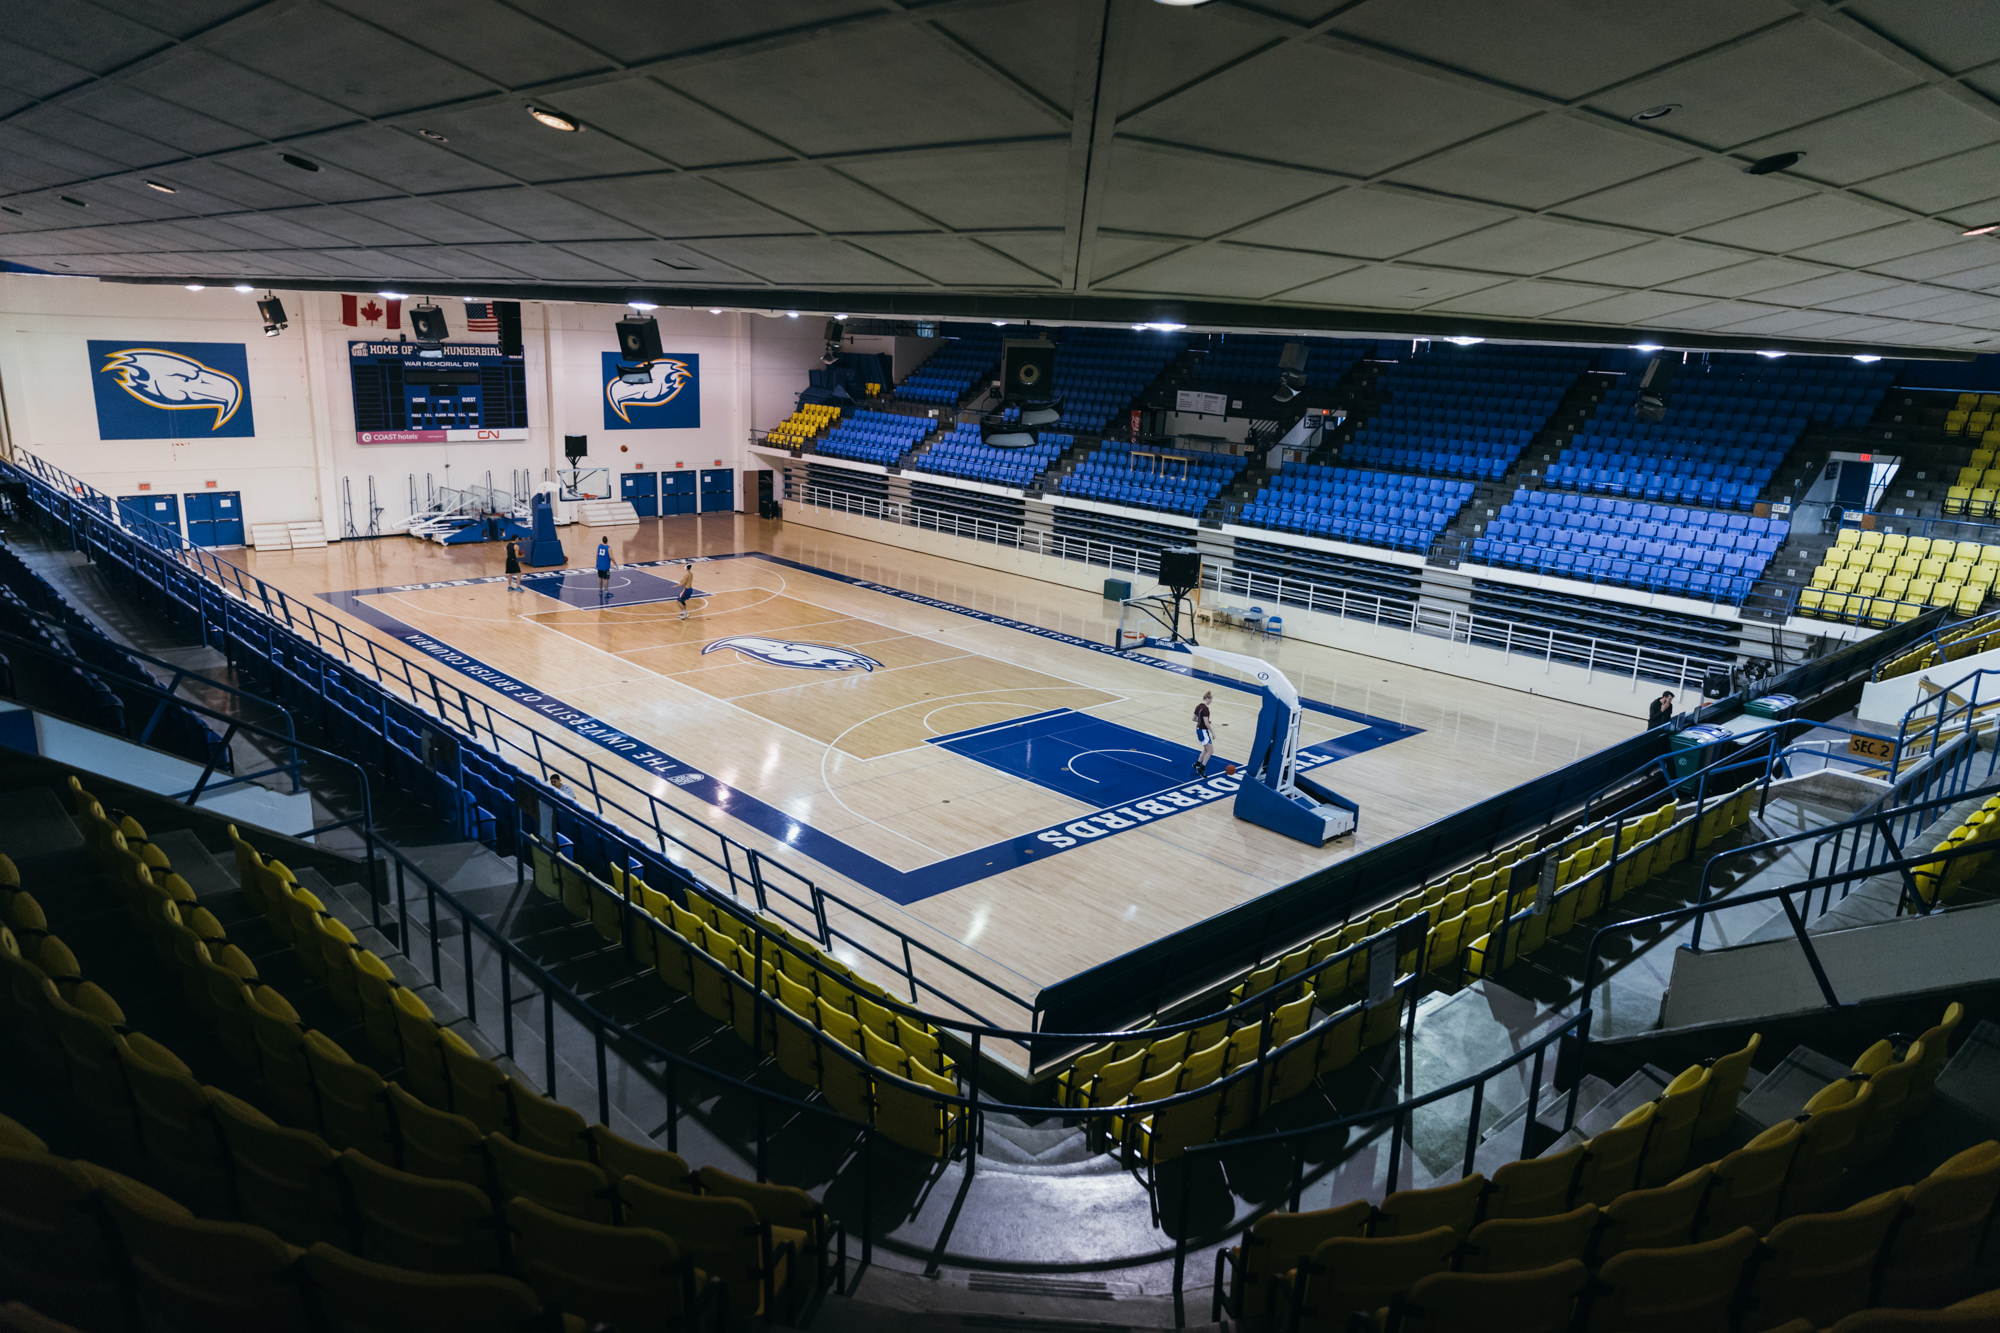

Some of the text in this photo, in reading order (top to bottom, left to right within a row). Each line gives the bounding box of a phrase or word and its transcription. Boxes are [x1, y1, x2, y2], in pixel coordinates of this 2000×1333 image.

[369, 345, 399, 355] HOME
[401, 345, 413, 355] OF
[443, 346, 503, 357] HUNDERBIR
[477, 430, 500, 440] CN
[393, 580, 474, 592] WAR
[655, 556, 717, 566] GYM
[870, 585, 1188, 674] THE UNIVERSITY OF BRITISH COLUMBIA
[405, 634, 677, 773] THE UNIVERSITY OF BRITISH COLUMBIA
[1852, 739, 1890, 758] SEC. 2
